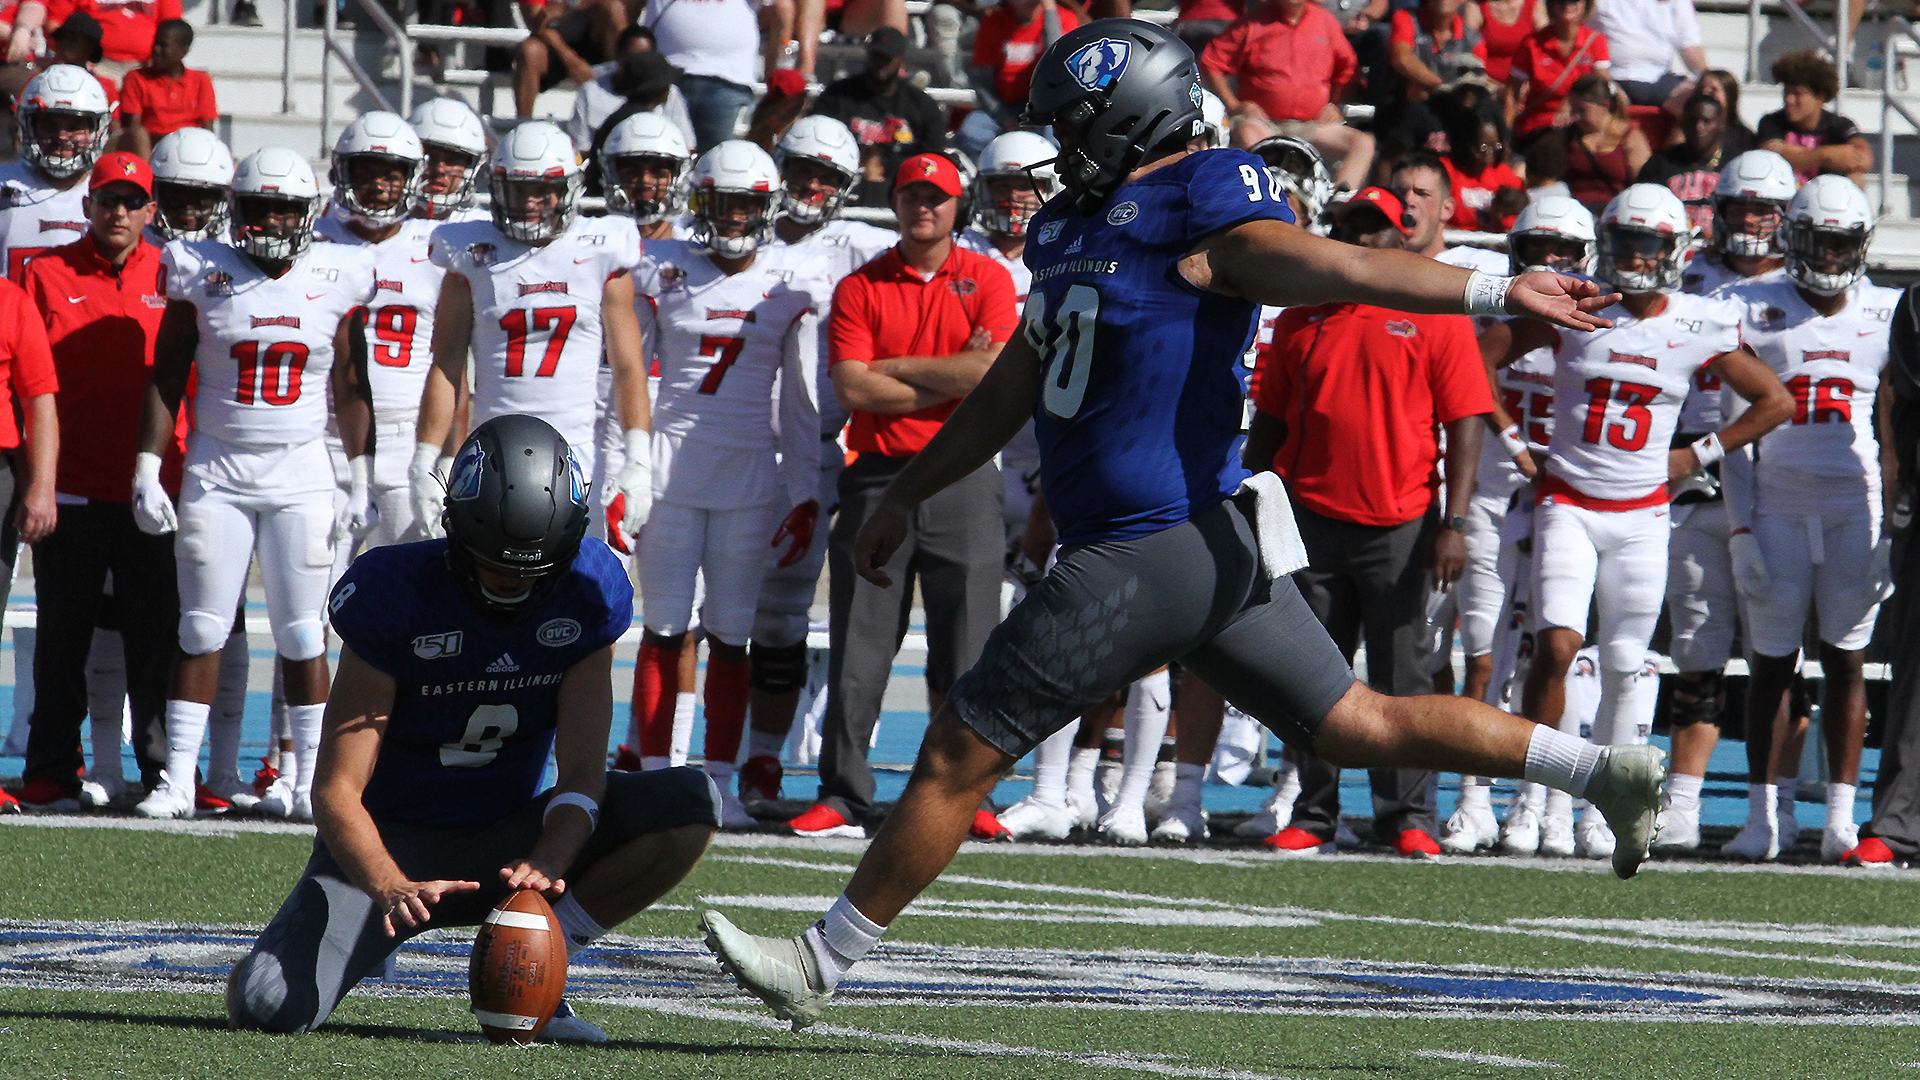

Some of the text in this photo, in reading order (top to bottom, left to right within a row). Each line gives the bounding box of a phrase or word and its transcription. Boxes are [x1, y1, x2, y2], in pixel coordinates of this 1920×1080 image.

[1238, 164, 1282, 203] 90
[1033, 260, 1119, 282] ASTERN ILLINOIS
[362, 305, 417, 367] 9
[500, 305, 577, 378] 17
[231, 340, 310, 406] 10
[697, 336, 744, 394] 7
[1583, 376, 1663, 452] 13
[330, 582, 356, 614] 8
[411, 631, 463, 660] 150
[546, 626, 571, 639] OVC
[486, 663, 520, 673] adidas
[421, 680, 499, 696] EASTERN
[439, 704, 519, 768] 8
